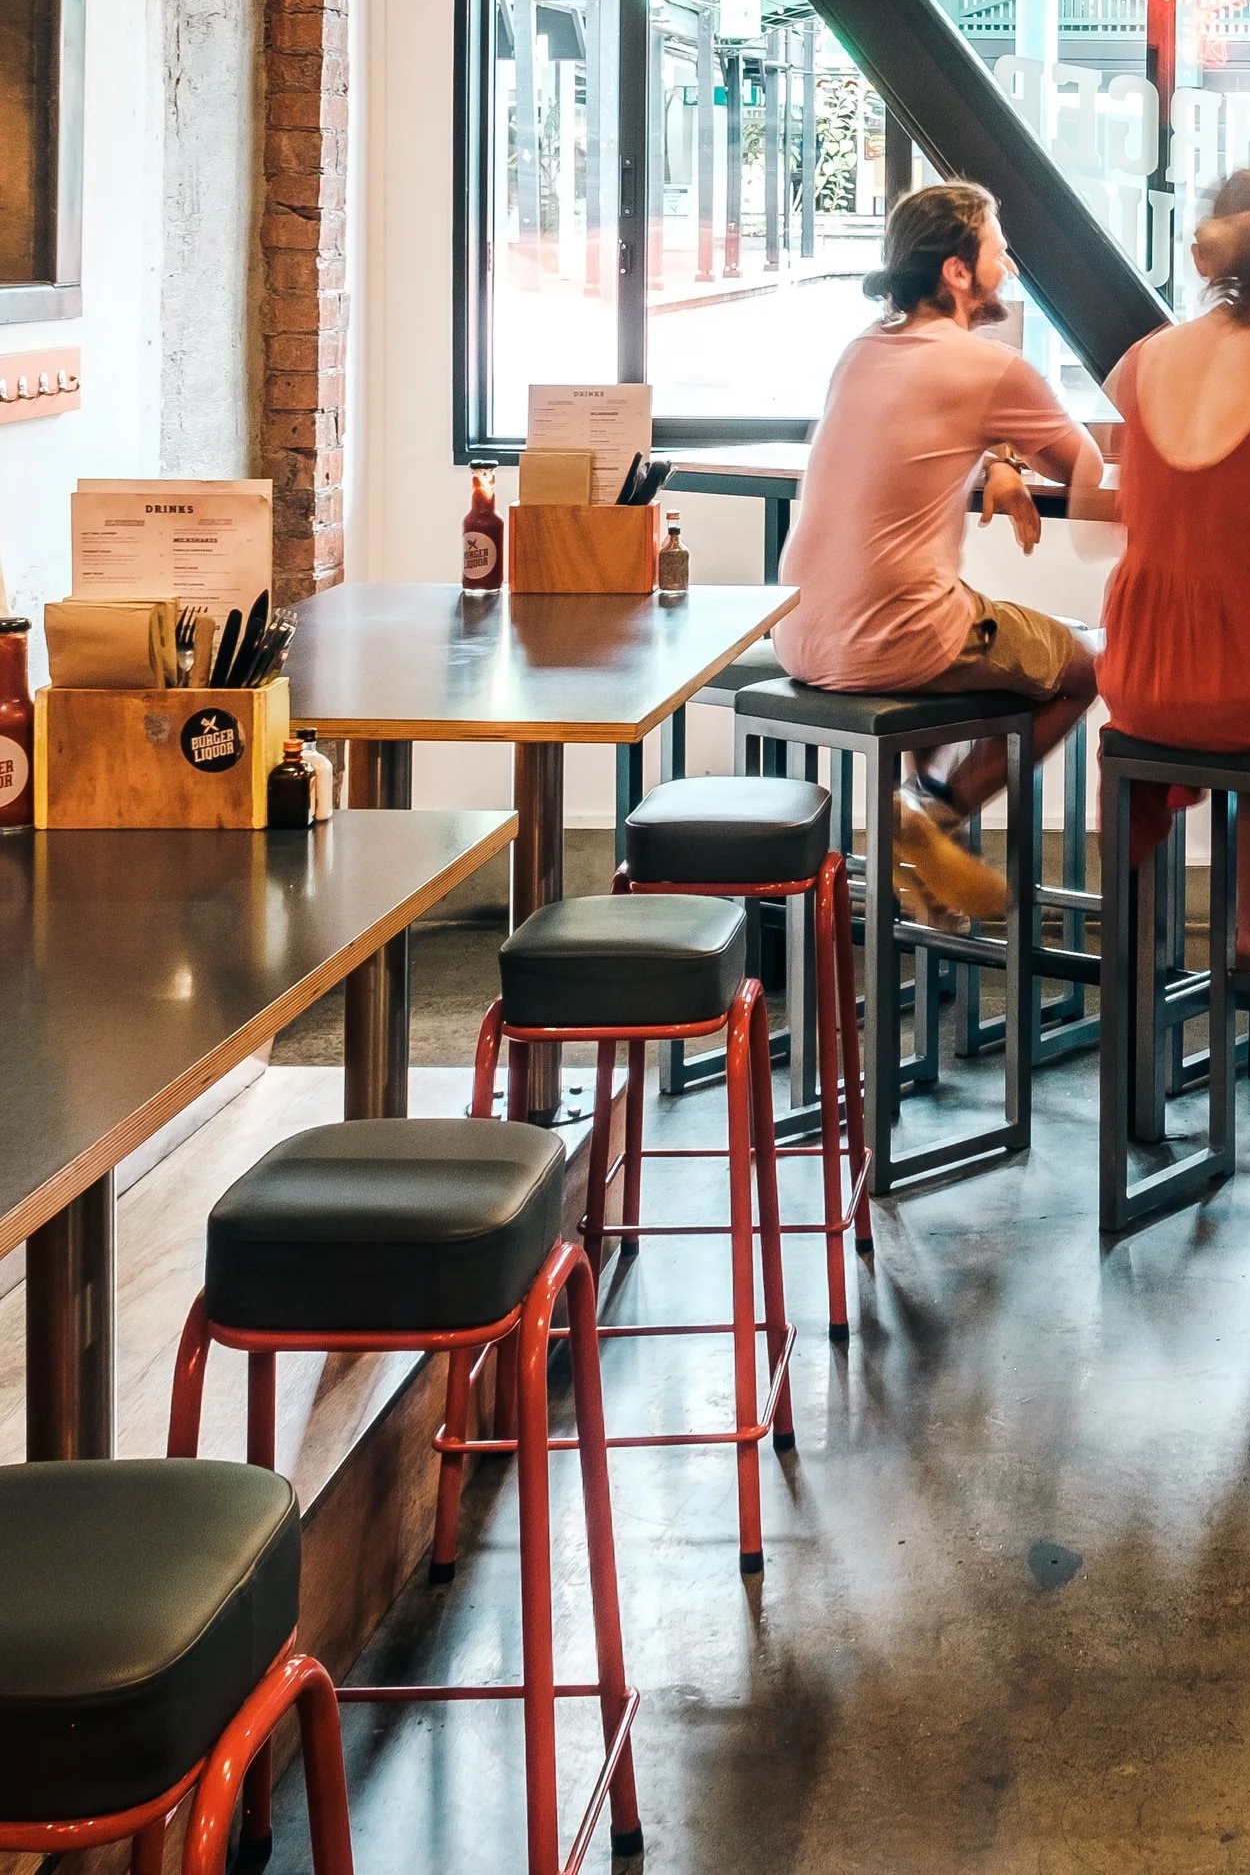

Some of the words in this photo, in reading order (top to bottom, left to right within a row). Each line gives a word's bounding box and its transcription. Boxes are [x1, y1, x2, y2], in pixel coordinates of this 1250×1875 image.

[573, 390, 604, 398] DRINKS
[145, 504, 194, 514] DRINKS
[191, 728, 235, 750] BURGER
[194, 741, 235, 763] LIQUOR
